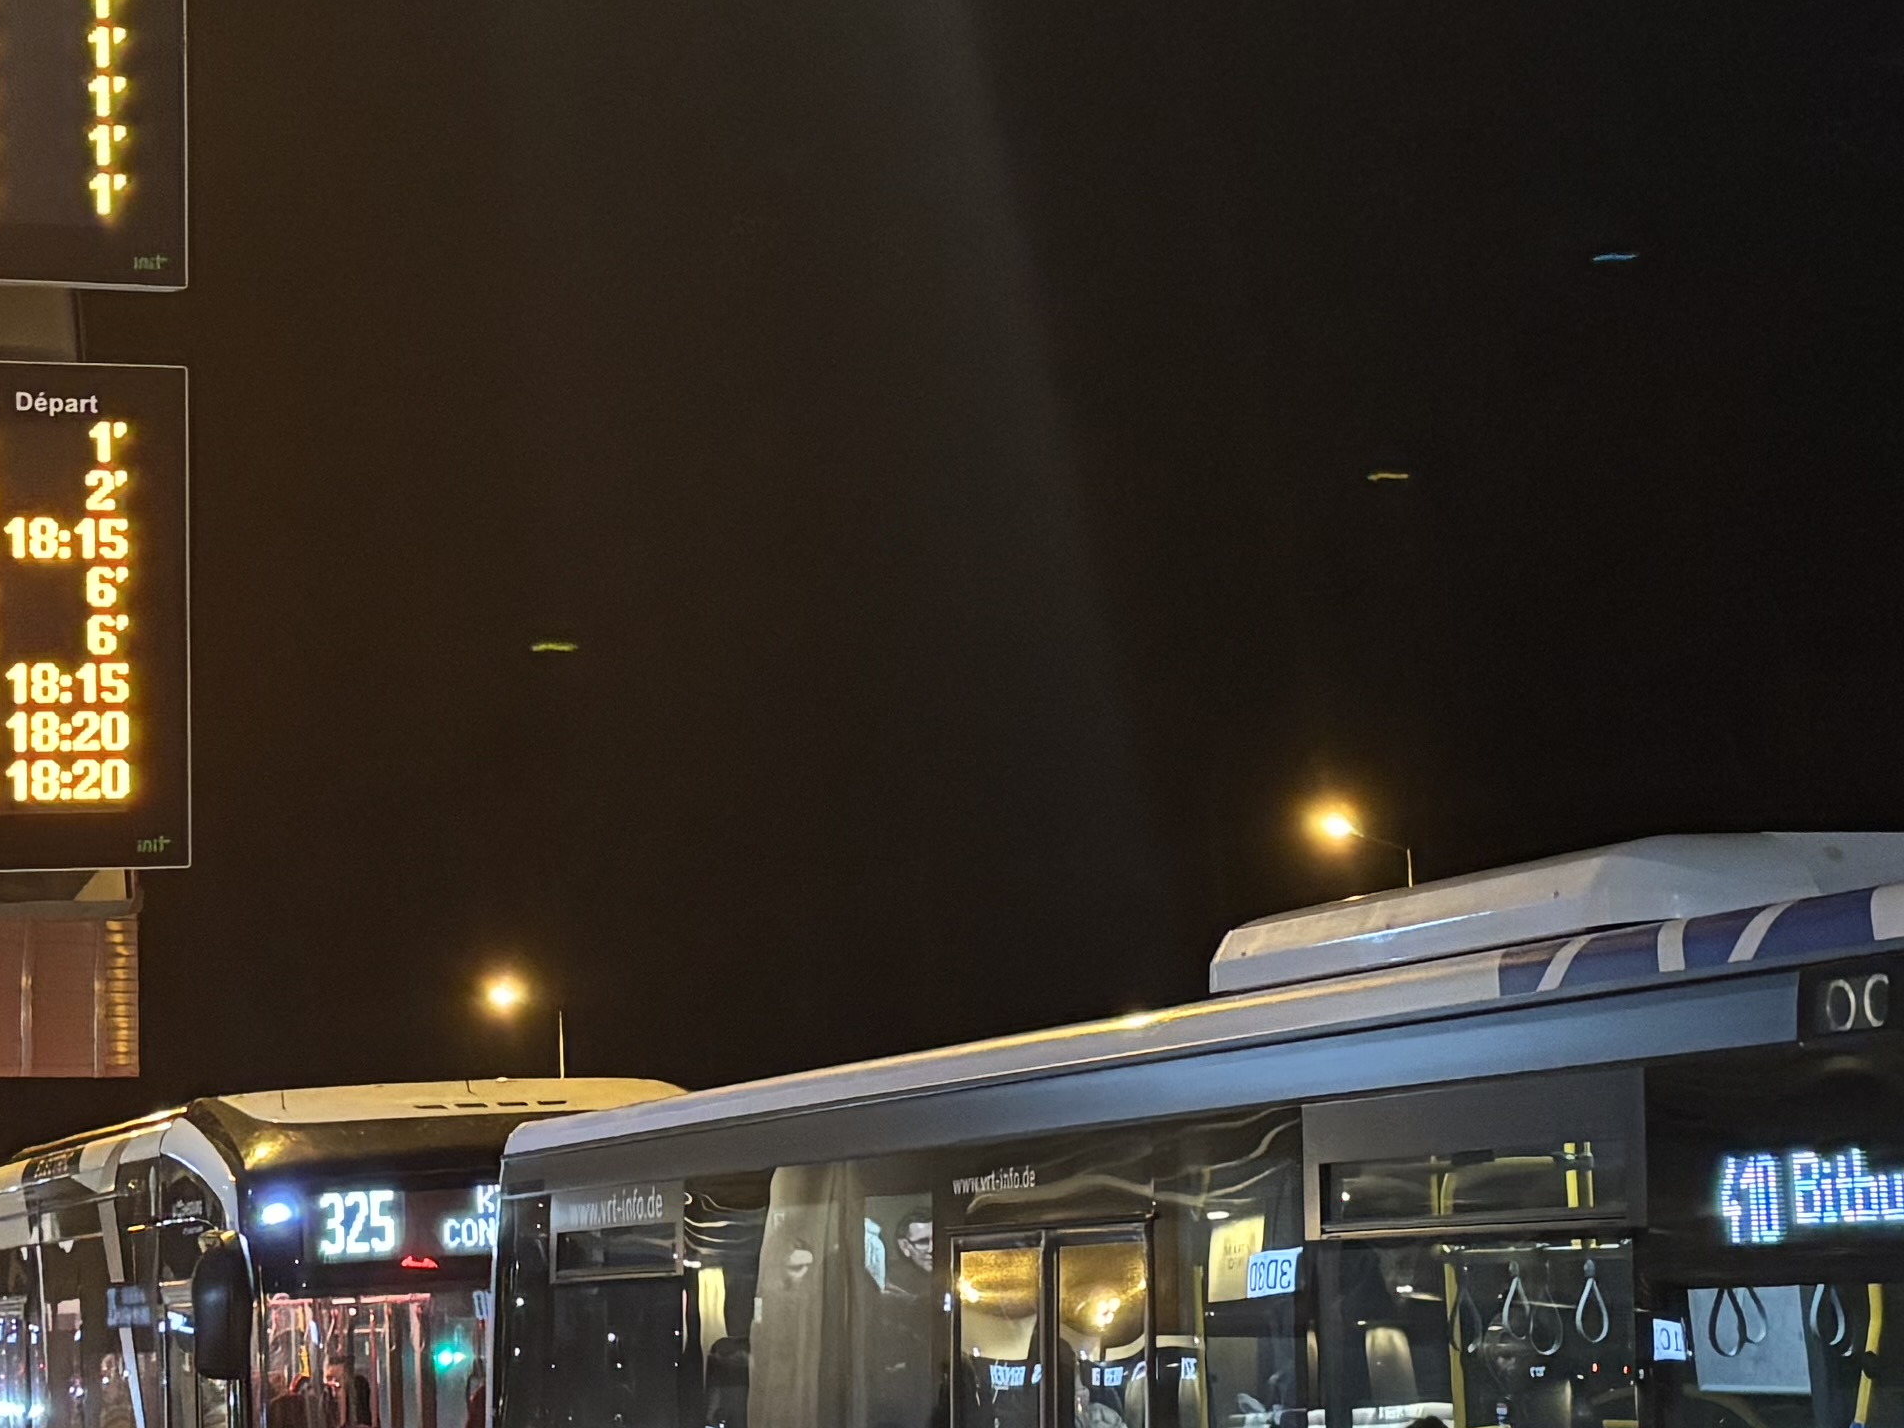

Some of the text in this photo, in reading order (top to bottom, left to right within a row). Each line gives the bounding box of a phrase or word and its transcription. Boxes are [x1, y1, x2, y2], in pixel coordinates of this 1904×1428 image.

[14, 390, 99, 417] Départ
[3, 517, 129, 560] 18:15
[5, 662, 130, 704] 18:15
[5, 710, 130, 753] 18:20
[5, 758, 131, 802] 18:20
[319, 1189, 395, 1256] 325
